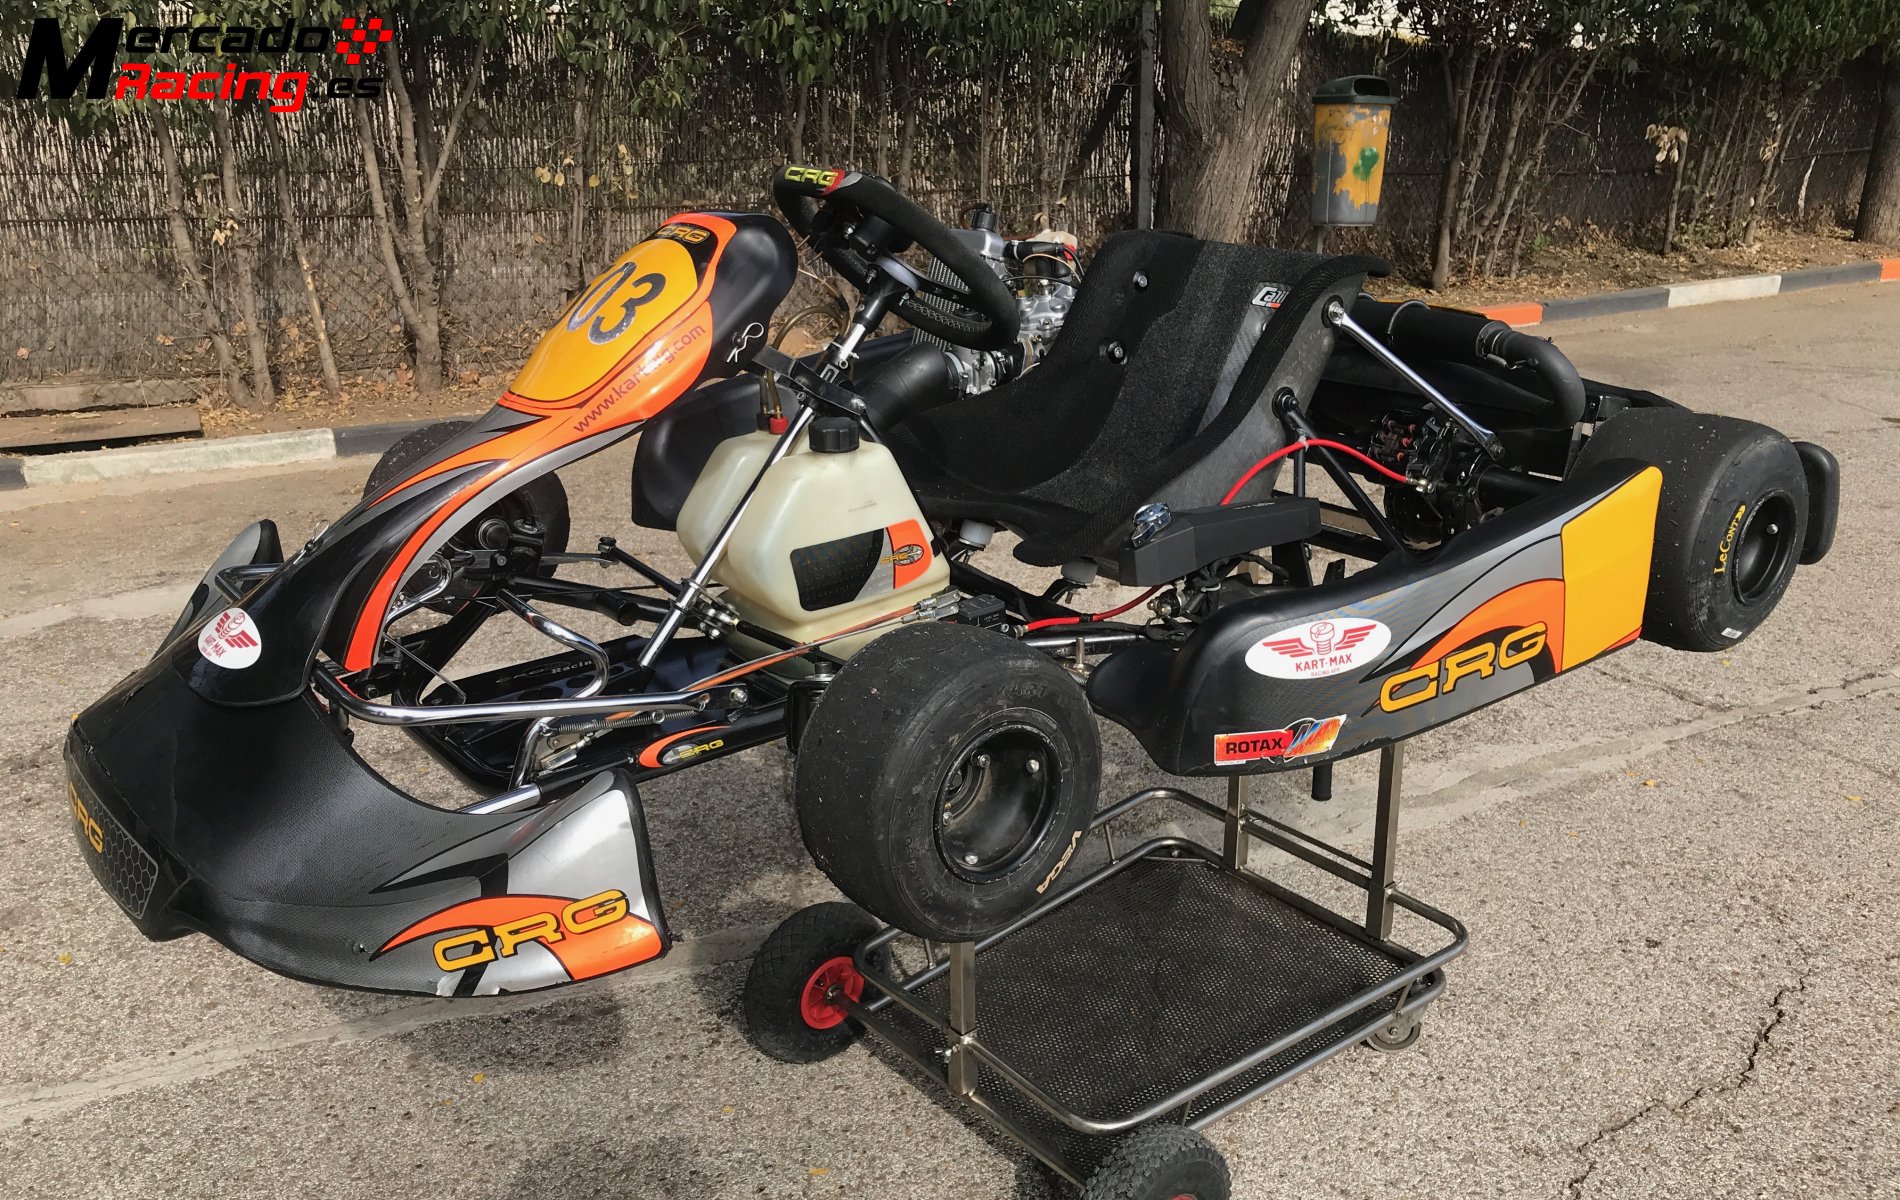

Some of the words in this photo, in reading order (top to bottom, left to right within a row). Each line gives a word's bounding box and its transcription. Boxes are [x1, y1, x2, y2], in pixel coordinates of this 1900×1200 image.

[784, 166, 839, 186] CRG
[656, 225, 710, 244] CRG
[551, 660, 594, 674] Racin
[1379, 621, 1547, 714] CRG
[679, 739, 725, 759] CRG
[1225, 737, 1285, 755] ROTAX
[69, 781, 103, 854] CRG
[1035, 830, 1083, 894] VEGA
[433, 889, 629, 972] CRG
